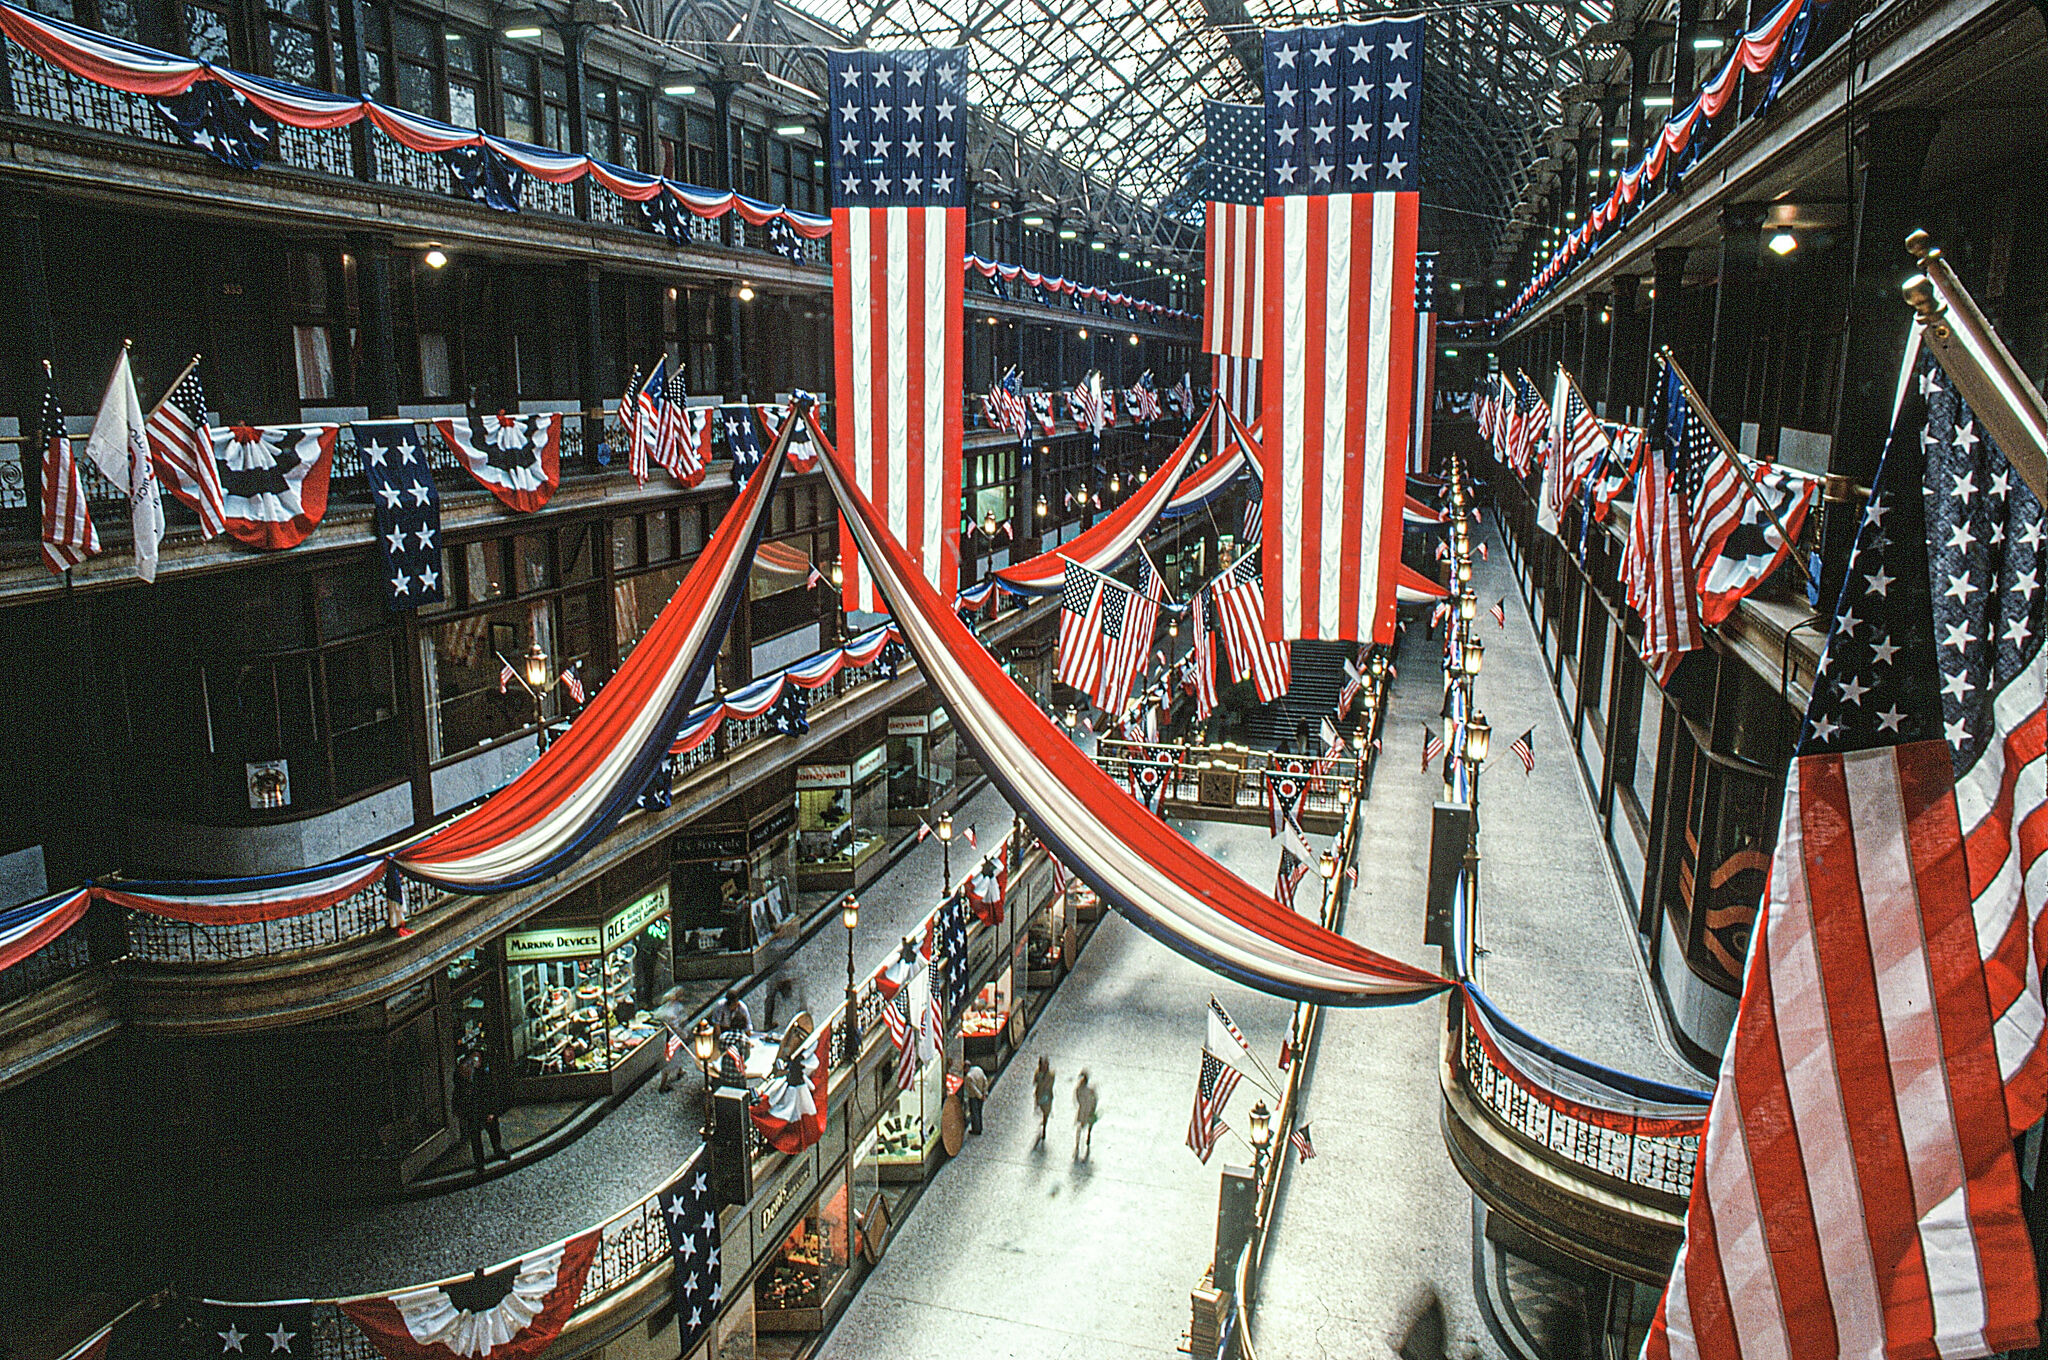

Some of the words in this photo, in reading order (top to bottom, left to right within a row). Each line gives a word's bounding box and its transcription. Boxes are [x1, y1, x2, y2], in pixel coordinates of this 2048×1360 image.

[607, 916, 625, 942] ACE
[511, 938, 555, 951] MARKING
[557, 935, 597, 948] DEVICES
